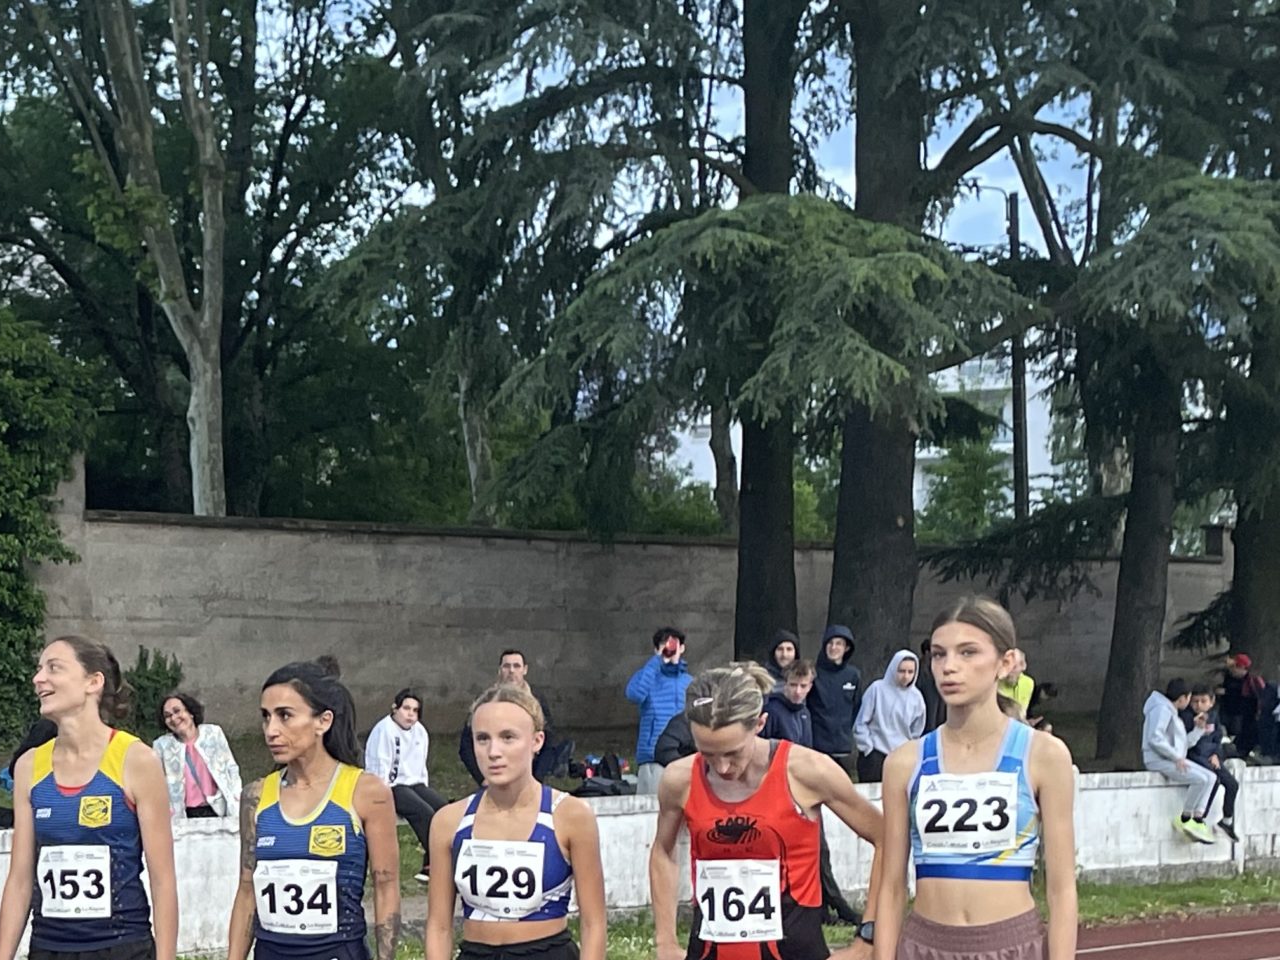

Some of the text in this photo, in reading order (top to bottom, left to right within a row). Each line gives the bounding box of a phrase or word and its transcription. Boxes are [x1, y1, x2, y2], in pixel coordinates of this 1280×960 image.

[922, 796, 1010, 834] 223
[43, 868, 105, 900] 153
[261, 882, 331, 915] 134
[462, 864, 536, 899] 129
[701, 886, 775, 922] 164
